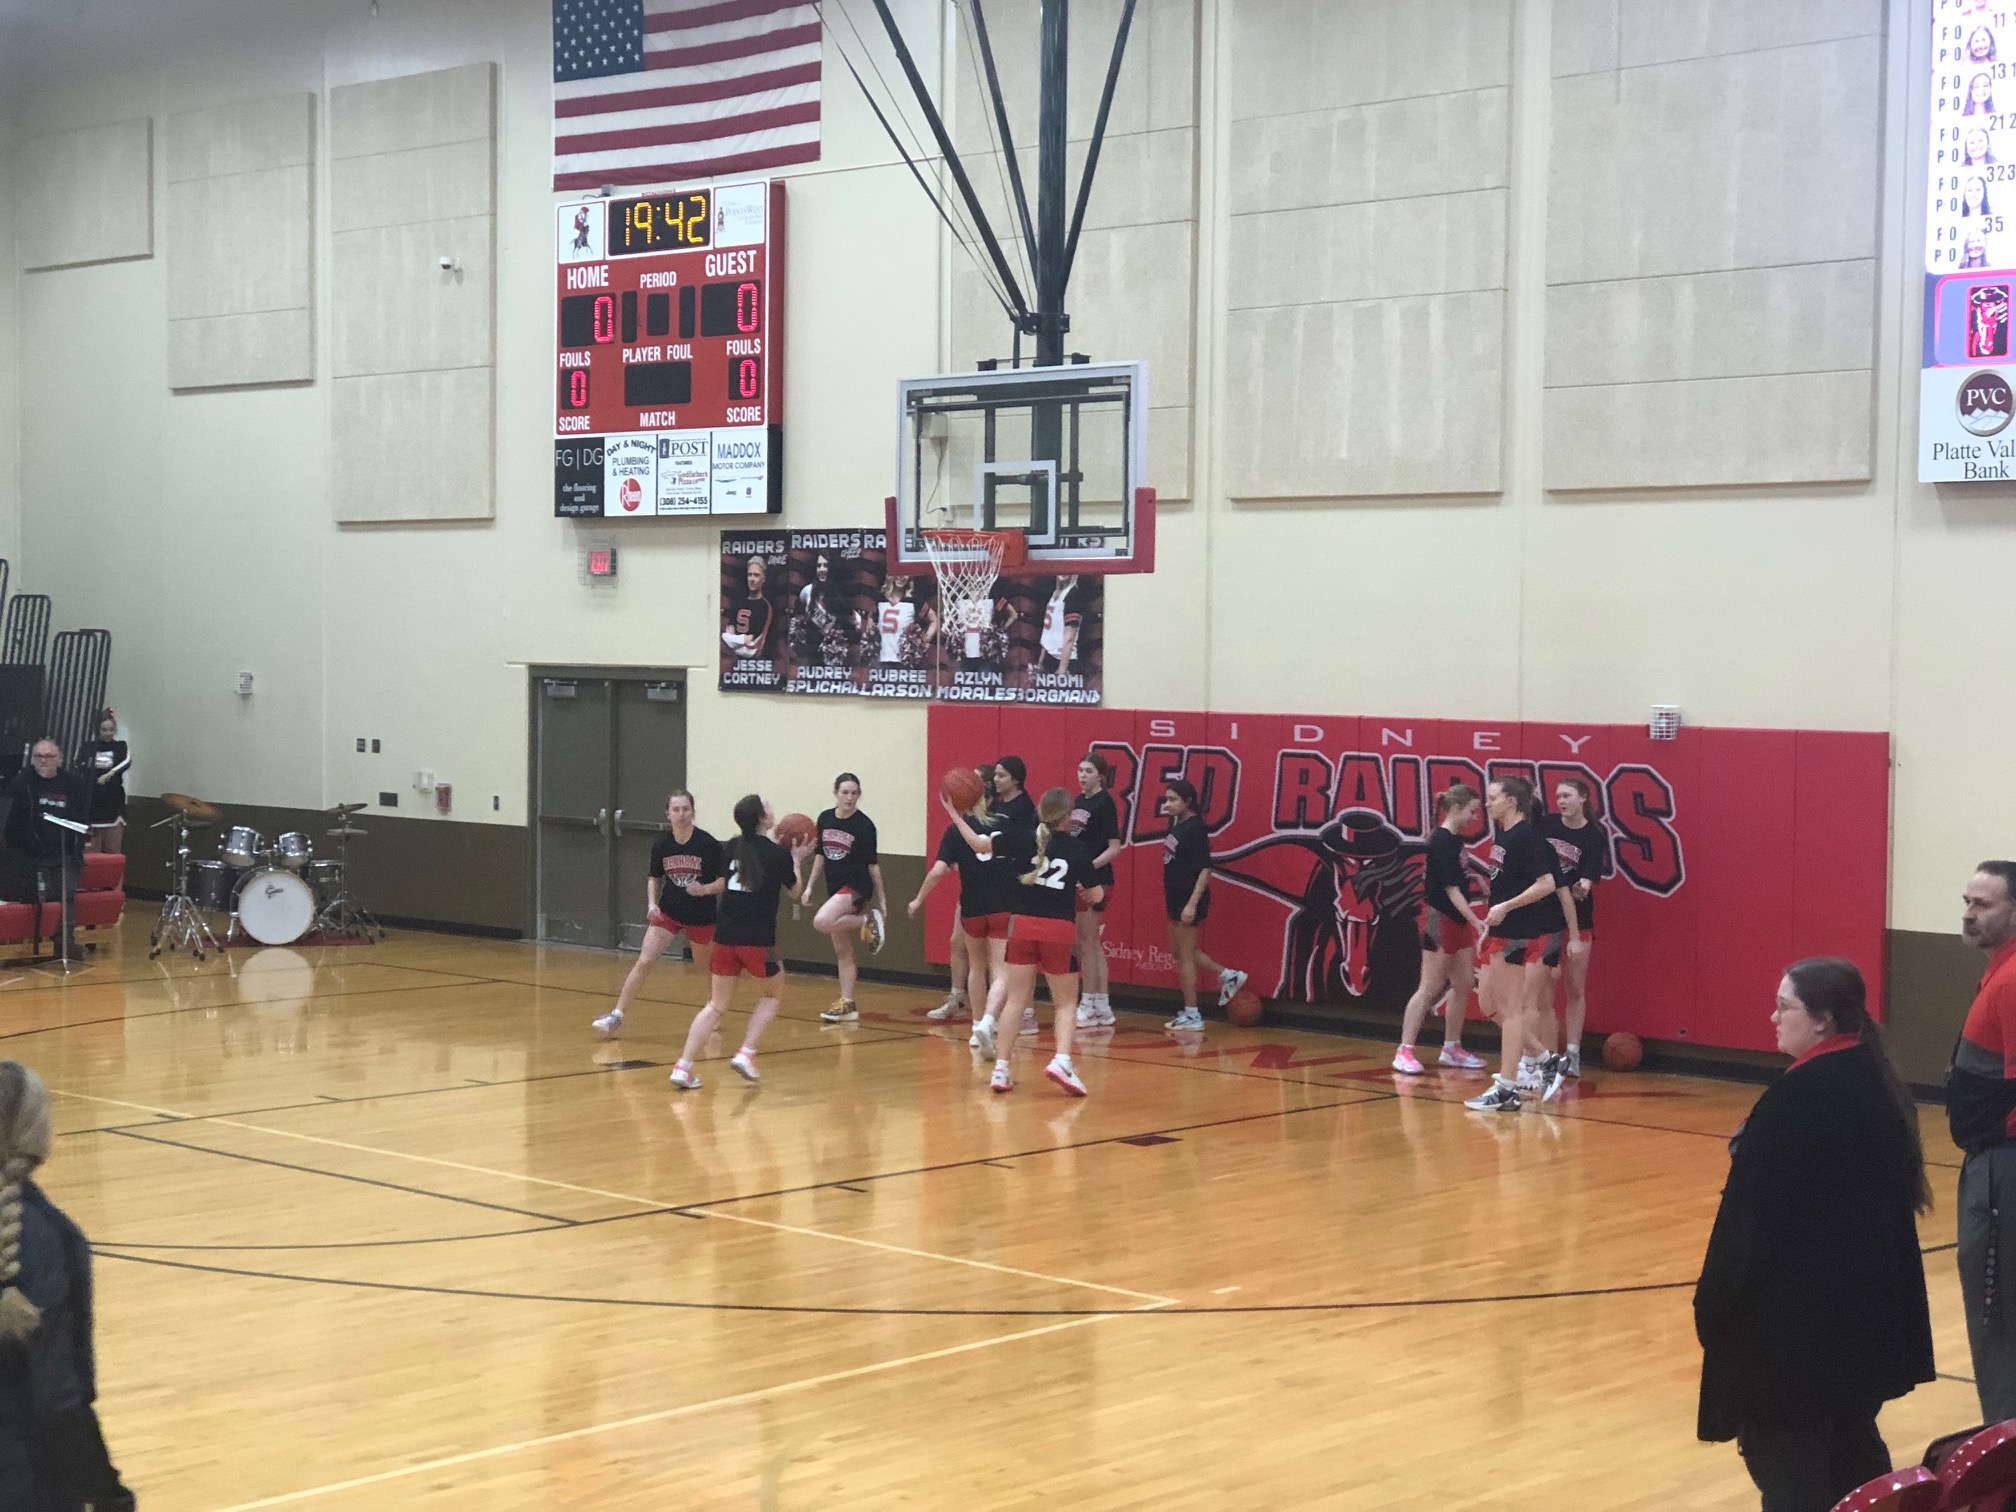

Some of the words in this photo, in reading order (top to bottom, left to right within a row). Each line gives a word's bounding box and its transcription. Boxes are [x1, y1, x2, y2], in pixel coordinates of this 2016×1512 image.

[625, 195, 707, 247] 19:42
[1984, 216, 2003, 233] 35
[705, 250, 757, 277] GUEST
[567, 265, 609, 290] HOME
[640, 271, 677, 289] PERIOD
[737, 283, 758, 332] 0
[593, 296, 613, 343] 0
[622, 346, 661, 363] PLAYER
[667, 344, 693, 360] FOUL
[726, 338, 761, 355] FOULS
[559, 351, 591, 367] FOULS
[739, 359, 757, 397] 0
[570, 370, 587, 407] 0
[1966, 387, 2006, 406] PVC
[559, 415, 591, 431] SCORE
[639, 411, 676, 427] MATCH
[726, 406, 761, 423] SCORE
[606, 441, 621, 456] DAY
[631, 439, 656, 454] NIGHT
[671, 441, 709, 455] POST
[717, 442, 761, 459] MADDOX
[1932, 443, 1982, 460] Platte
[1987, 440, 2016, 457] Val
[612, 456, 650, 466] PLUMBING
[712, 462, 734, 470] MOTOR
[735, 461, 765, 470] COMPANY
[1964, 460, 2010, 479] Bank
[612, 468, 617, 476] &
[619, 467, 650, 476] HEATING
[659, 497, 676, 506] (308)
[678, 496, 708, 505] 254-4155
[722, 540, 785, 555] RAIDERS
[791, 533, 861, 549] RAIDERS
[736, 609, 751, 633] S
[882, 609, 901, 634] S
[733, 659, 772, 672] JESSE
[796, 666, 852, 680] AUDREY
[723, 673, 780, 685] CORTNEY
[868, 669, 927, 683] AUBREE
[954, 671, 1003, 686] AZLYN
[1036, 673, 1084, 687] NAOMI
[859, 683, 933, 698] LARSON
[936, 685, 1018, 702] MORALES
[1089, 741, 1242, 848] RED
[1271, 749, 1686, 898] RAIDRS
[1030, 855, 1069, 890] 22
[1102, 940, 1145, 967] Sidney
